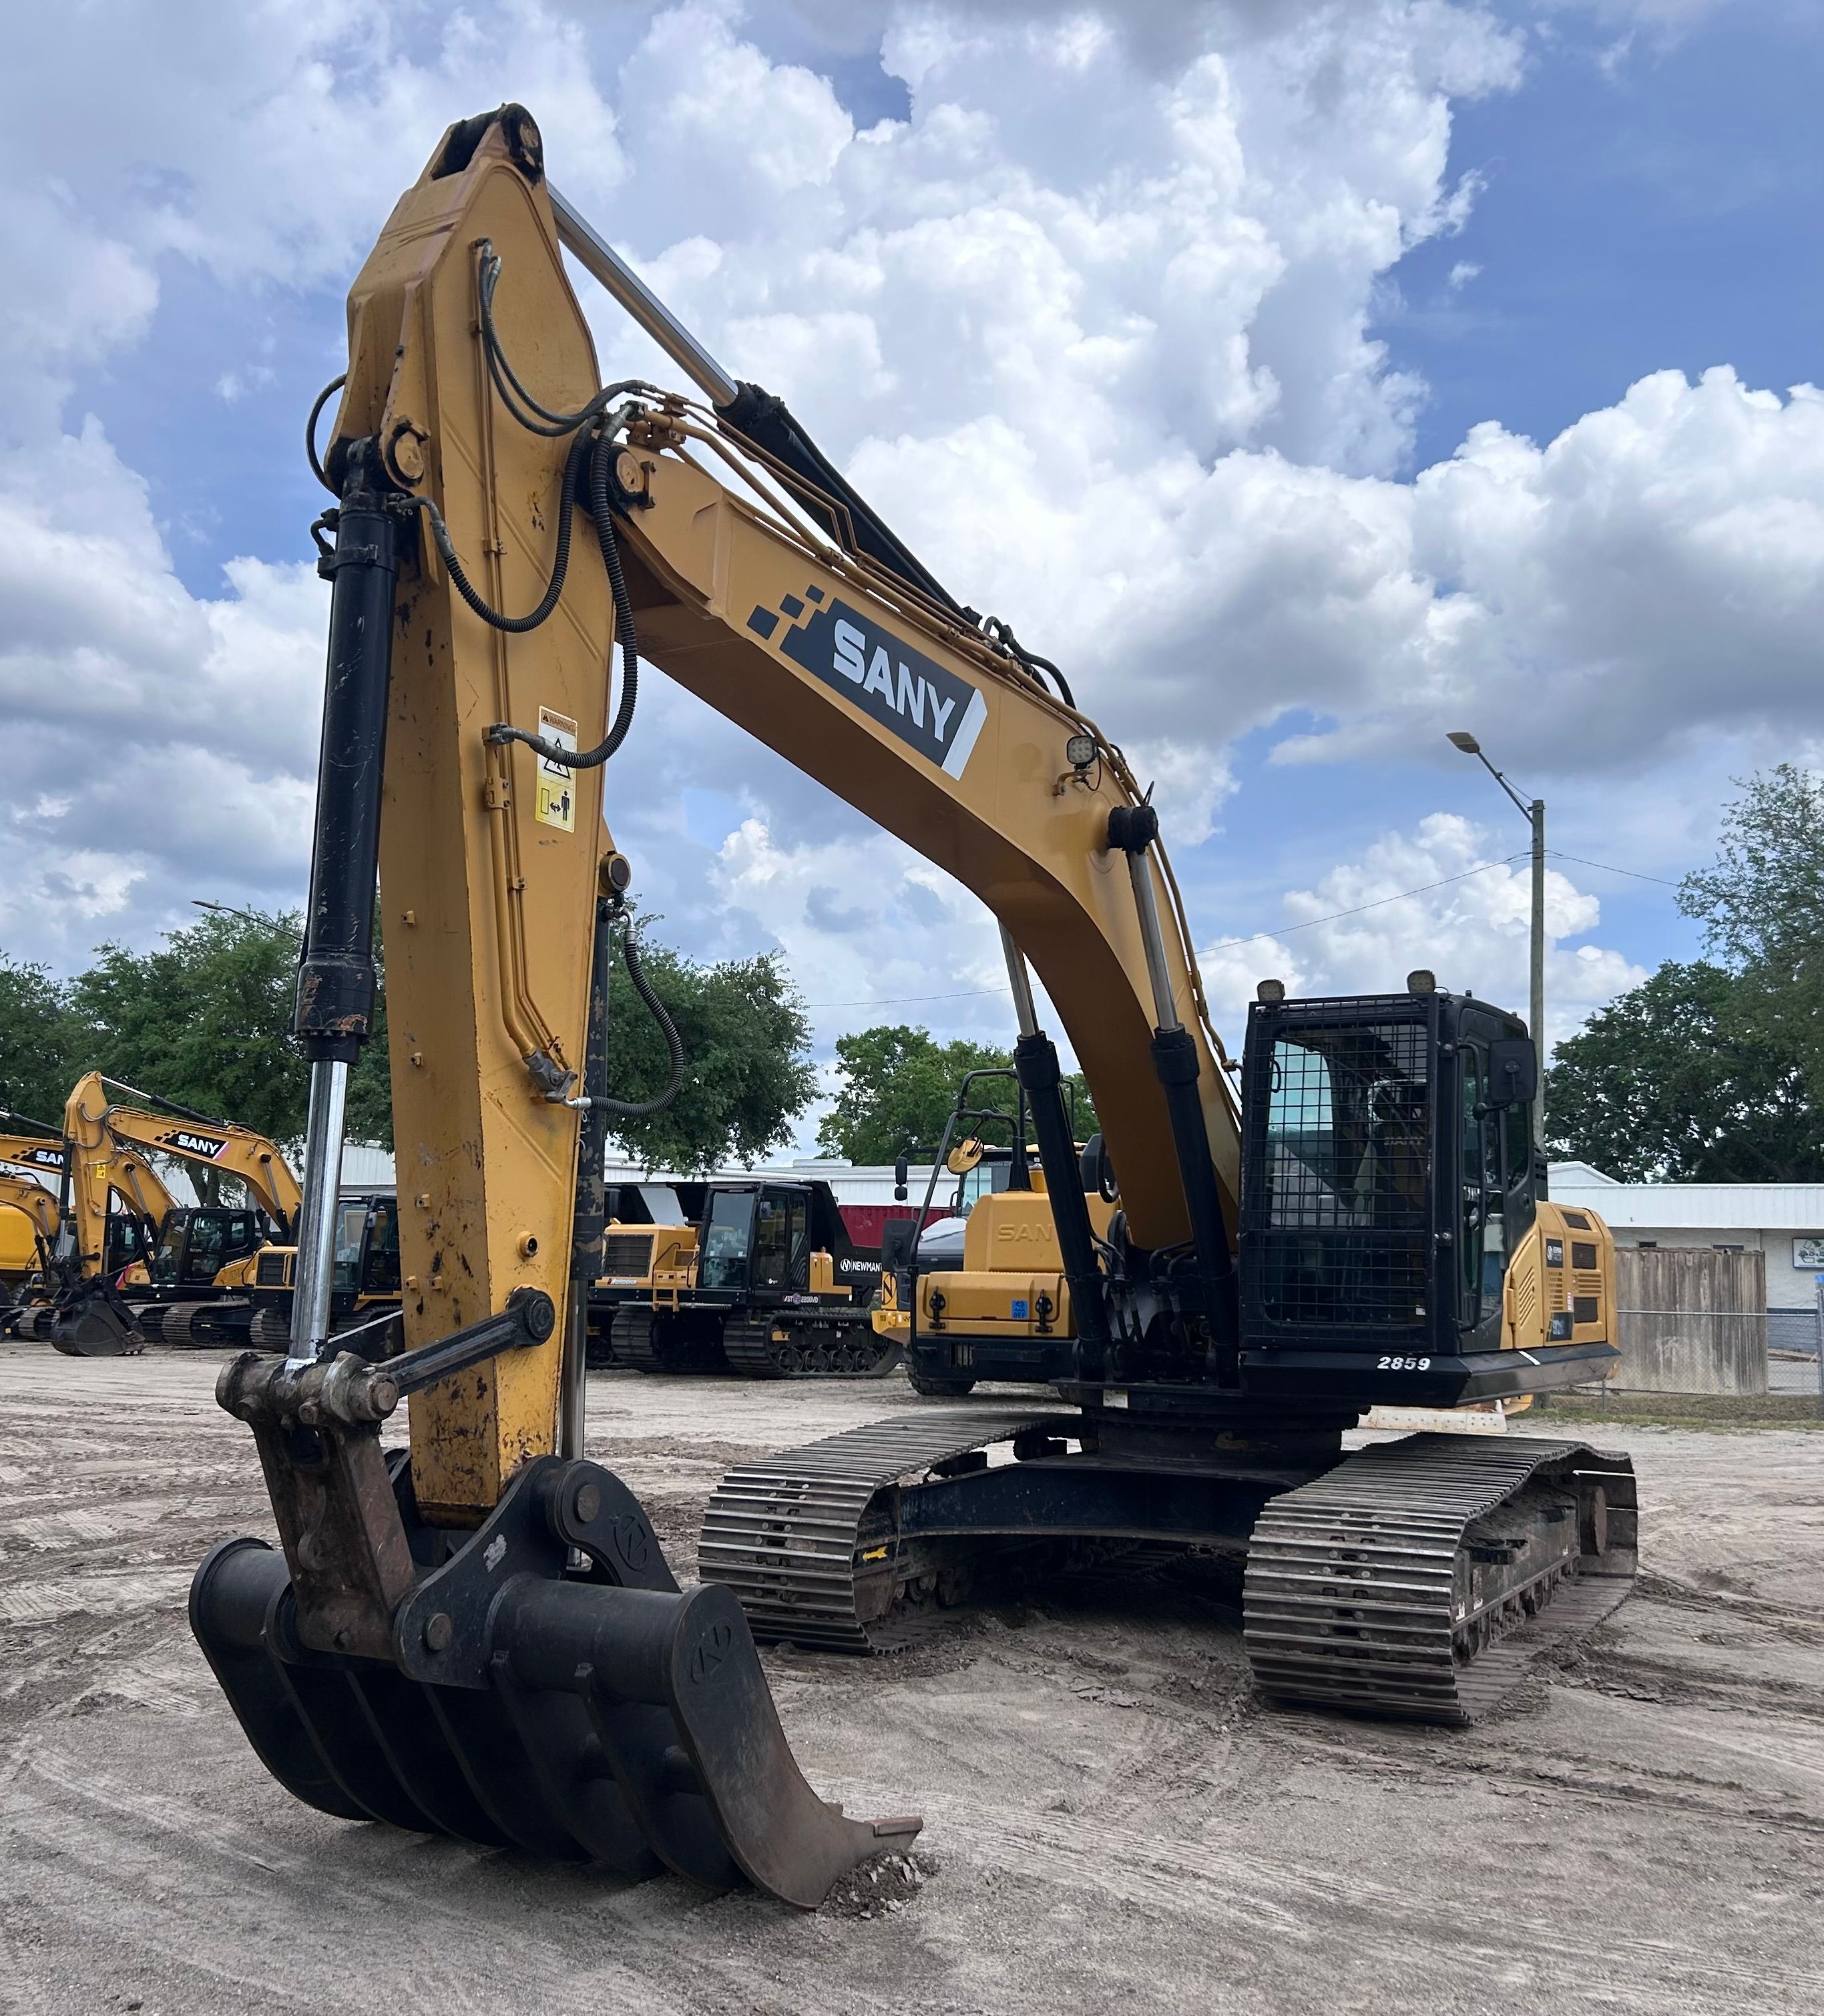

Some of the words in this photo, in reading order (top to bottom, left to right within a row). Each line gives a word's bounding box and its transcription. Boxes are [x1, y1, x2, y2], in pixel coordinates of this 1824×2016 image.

[833, 618, 955, 742] SANY
[549, 715, 574, 732] WARNING
[178, 1134, 219, 1154] SANY
[36, 1150, 63, 1165] SAN
[998, 1224, 1053, 1242] SAN
[1377, 1356, 1431, 1370] 2859
